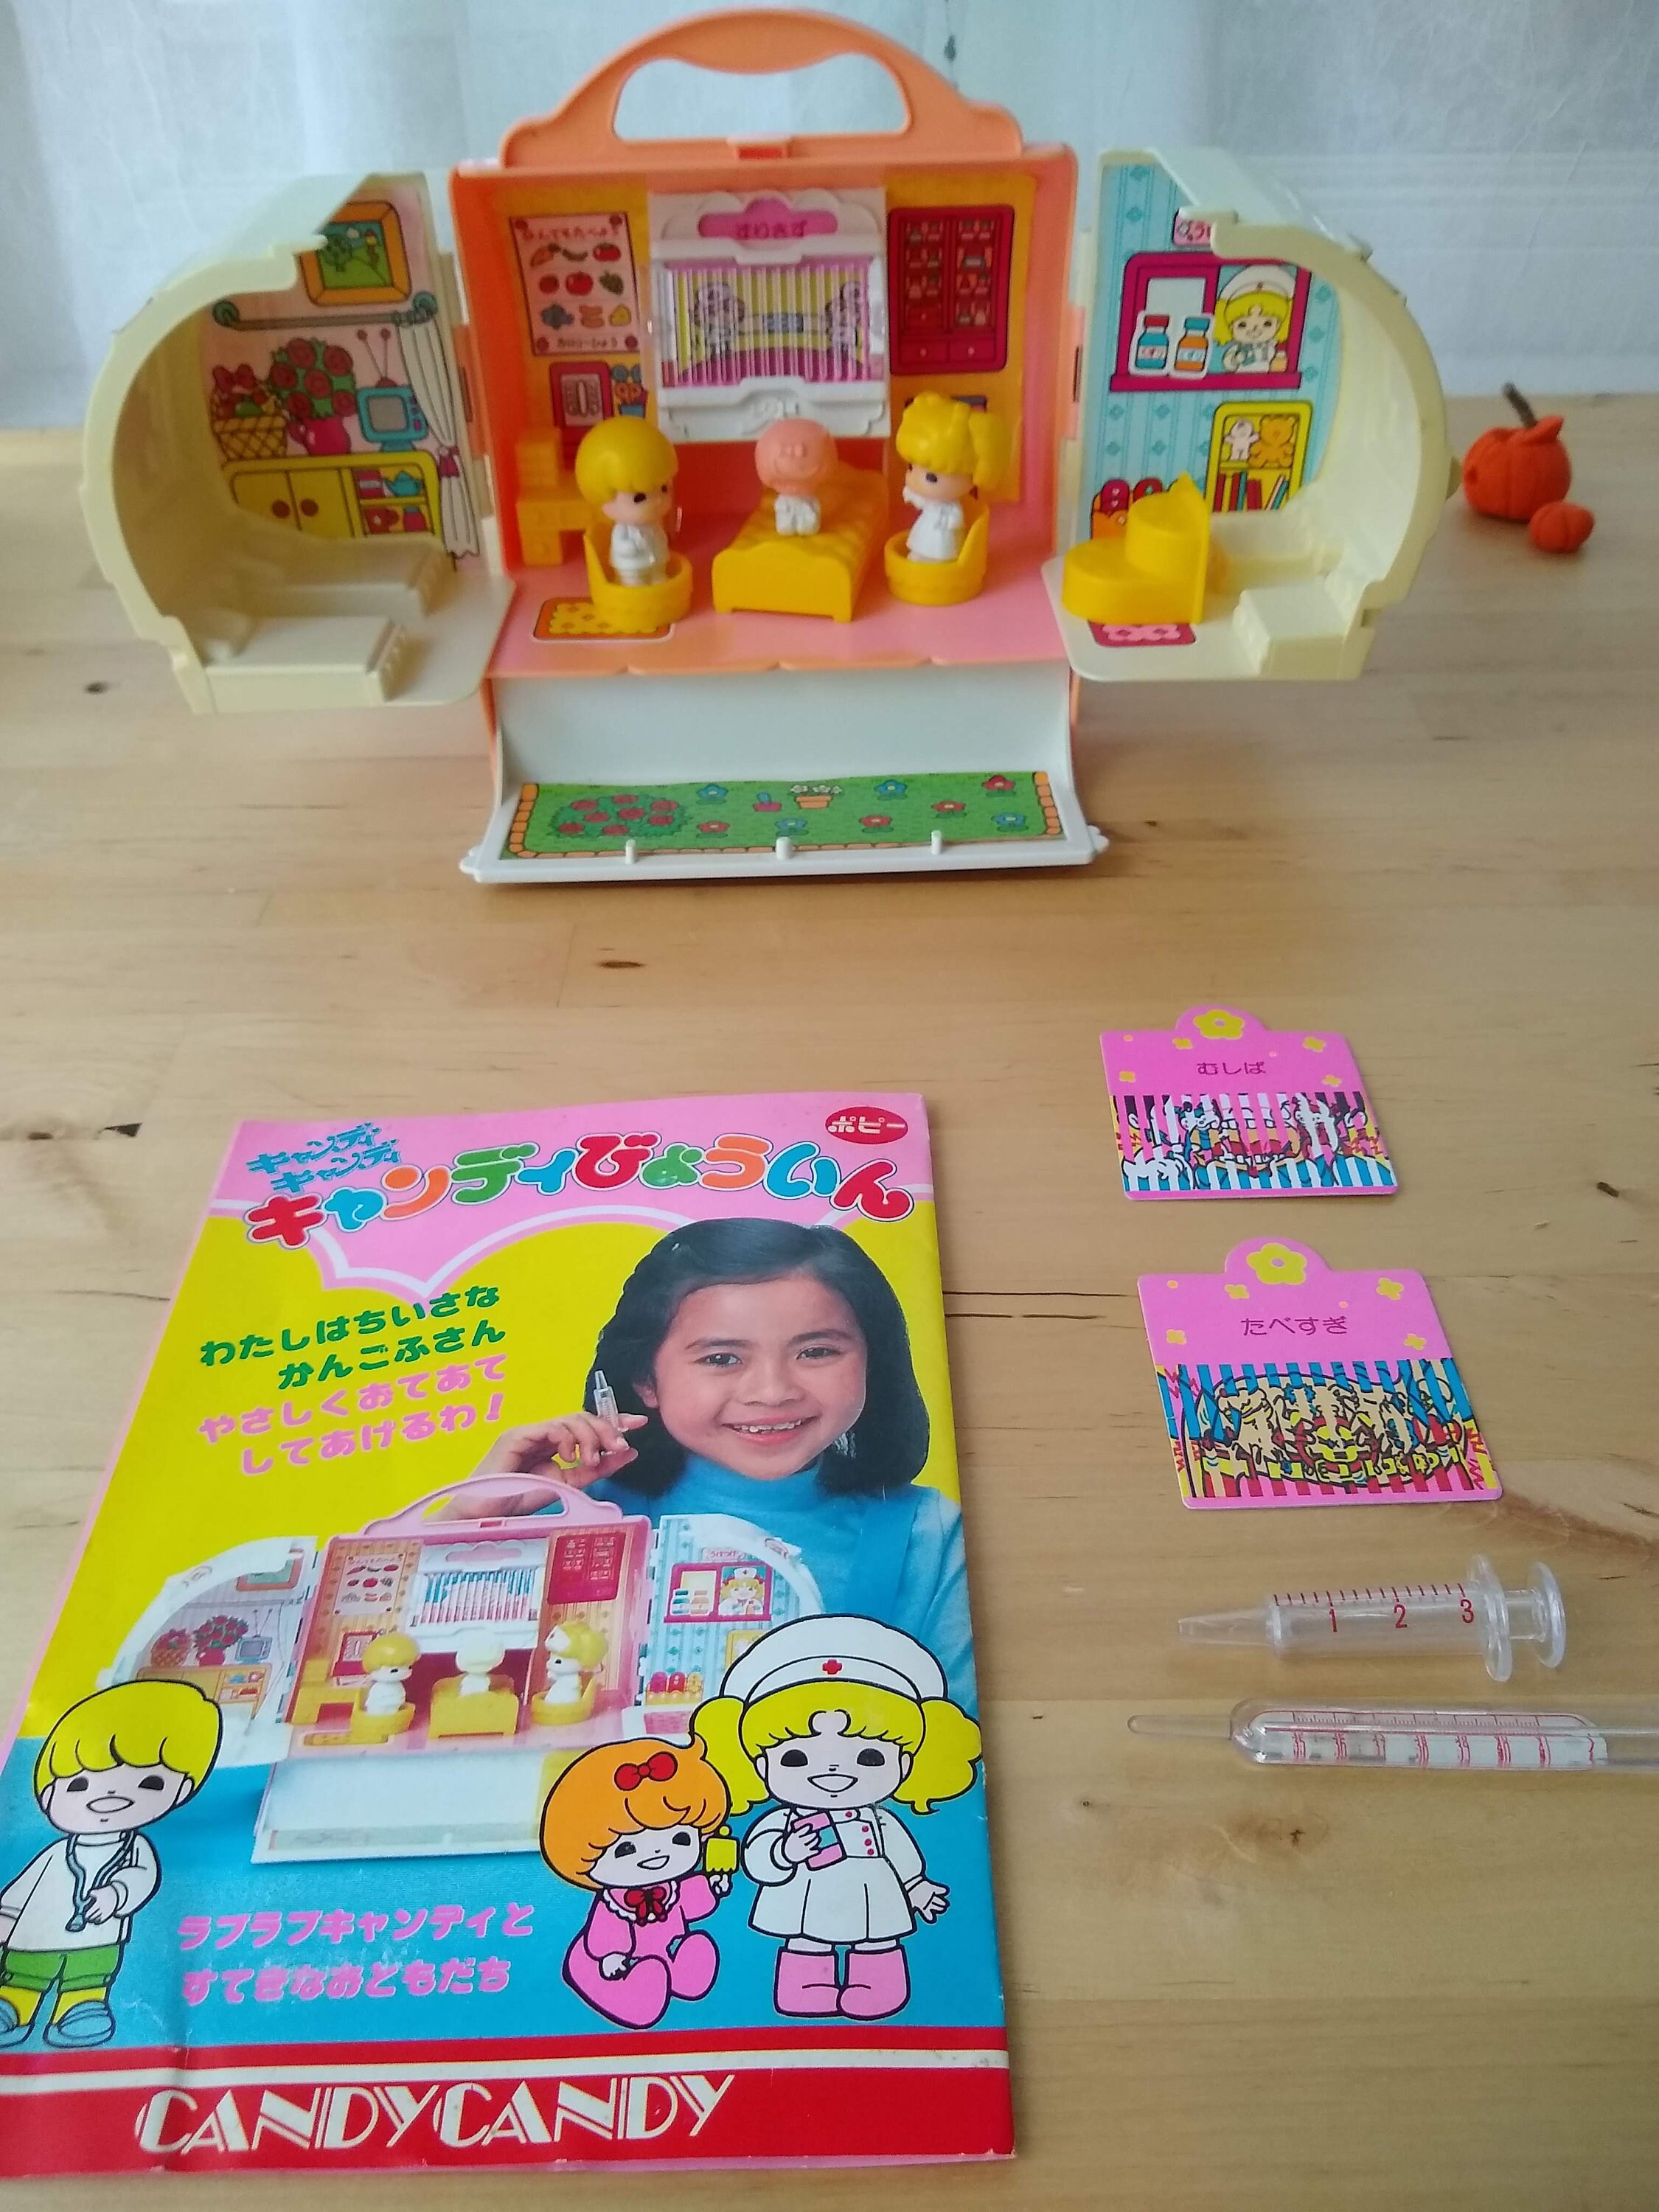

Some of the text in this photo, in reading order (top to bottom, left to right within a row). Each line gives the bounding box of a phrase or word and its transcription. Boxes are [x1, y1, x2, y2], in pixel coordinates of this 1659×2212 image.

[1197, 1061, 1265, 1076] むしば
[246, 1122, 381, 1174] キャンディ
[826, 1115, 907, 1134] ポピー
[245, 1133, 914, 1249] キャンディびょういん
[271, 1139, 400, 1192] キャンディ
[200, 1285, 500, 1366] わたしはちいさな
[1240, 1316, 1348, 1336] たべすぎ
[277, 1318, 506, 1389] かんごふさん
[198, 1354, 507, 1445] やさしくおてあて
[1328, 1599, 1475, 1632] 1 2 3
[178, 1903, 535, 1950] ラフラフキャンディと
[182, 1956, 510, 2006] すてきなおともだち
